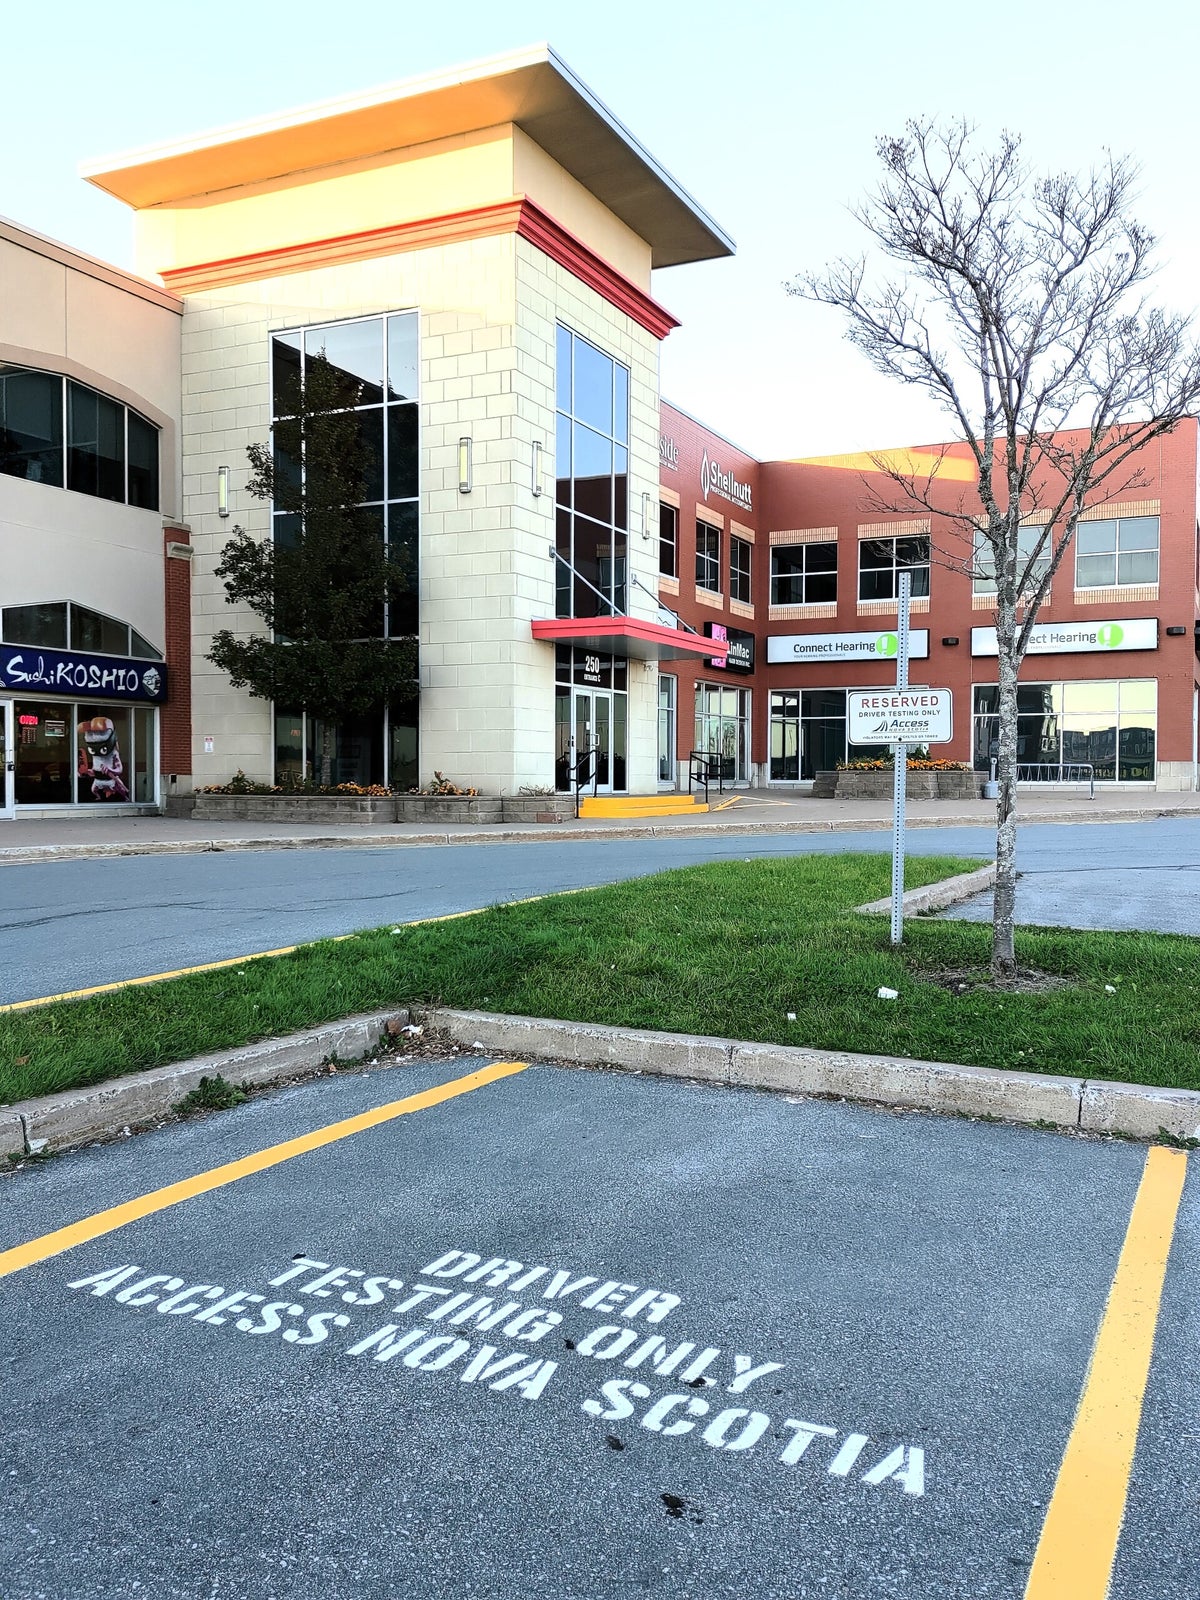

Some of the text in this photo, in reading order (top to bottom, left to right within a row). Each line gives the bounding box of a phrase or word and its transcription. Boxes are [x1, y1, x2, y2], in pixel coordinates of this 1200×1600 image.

[710, 461, 752, 504] Shellnutt
[793, 642, 876, 653] Connect Hearing
[1050, 632, 1097, 643] Hearing
[6, 654, 139, 692] Sushi KOSHIO
[585, 655, 600, 674] 250
[861, 696, 939, 708] RESERVED
[890, 719, 929, 728] Access
[419, 1250, 682, 1324] DRIVER
[268, 1258, 785, 1394] TESTING ONLY
[67, 1264, 925, 1496] ACCESS NOVA SCOTIA
